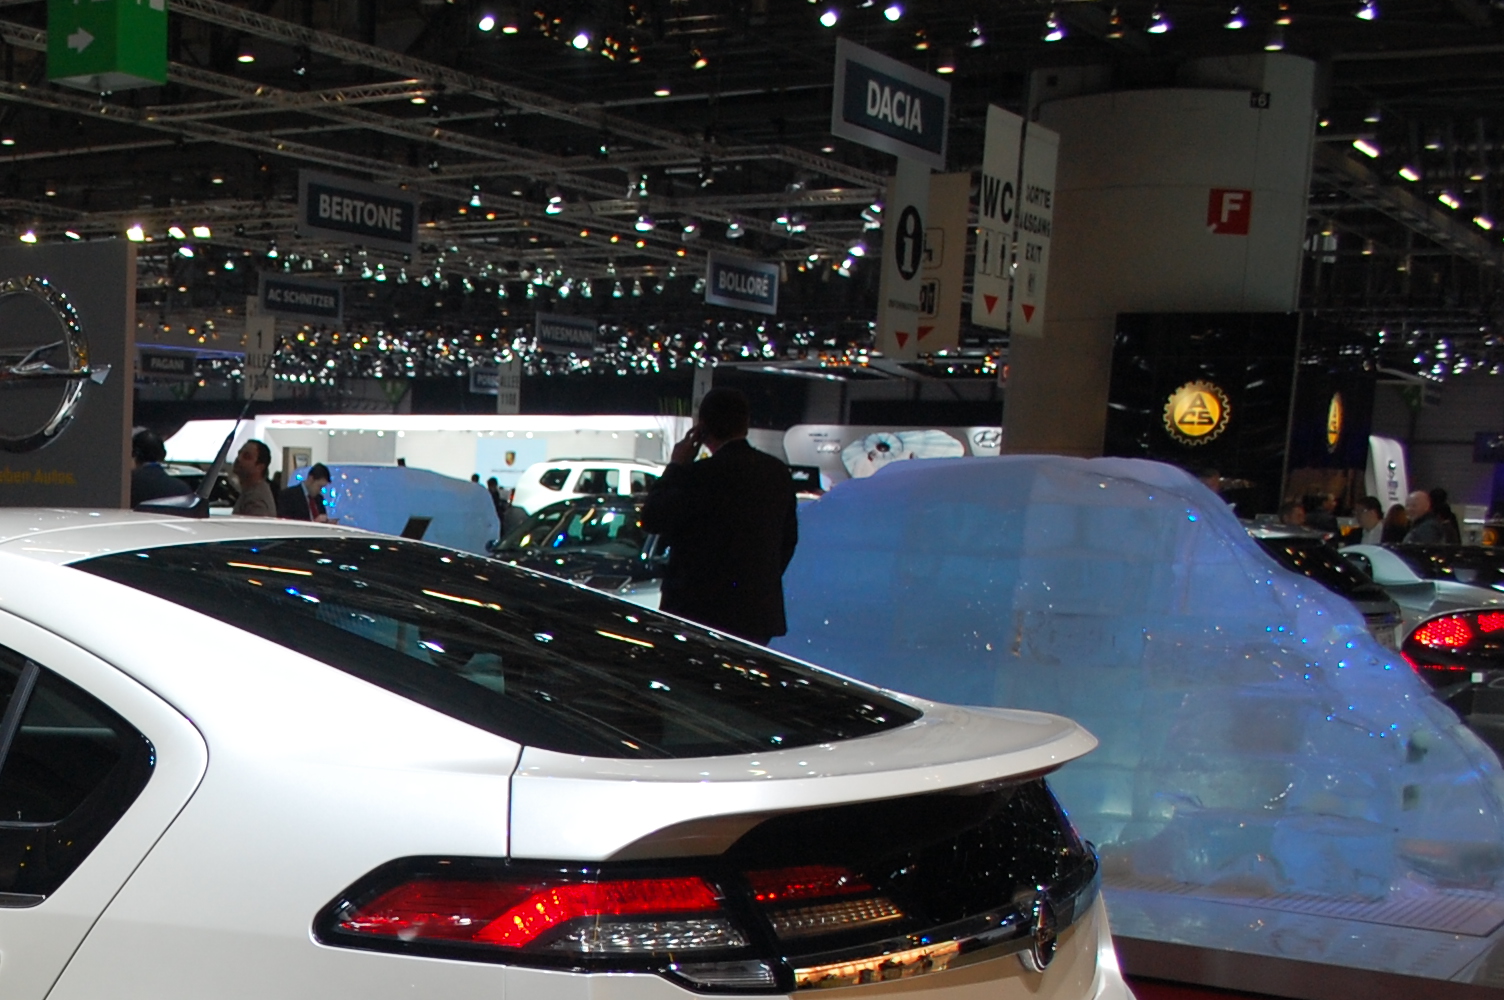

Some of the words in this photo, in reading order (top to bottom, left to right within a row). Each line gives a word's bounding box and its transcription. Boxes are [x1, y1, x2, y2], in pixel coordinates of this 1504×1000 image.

[866, 79, 923, 134] DACIA
[319, 193, 402, 231] BERTONE
[983, 174, 1014, 223] WC
[1220, 192, 1244, 223] F
[267, 288, 282, 301] AC
[283, 290, 336, 307] SCHNITZER
[718, 270, 769, 298] BOLLORÉ
